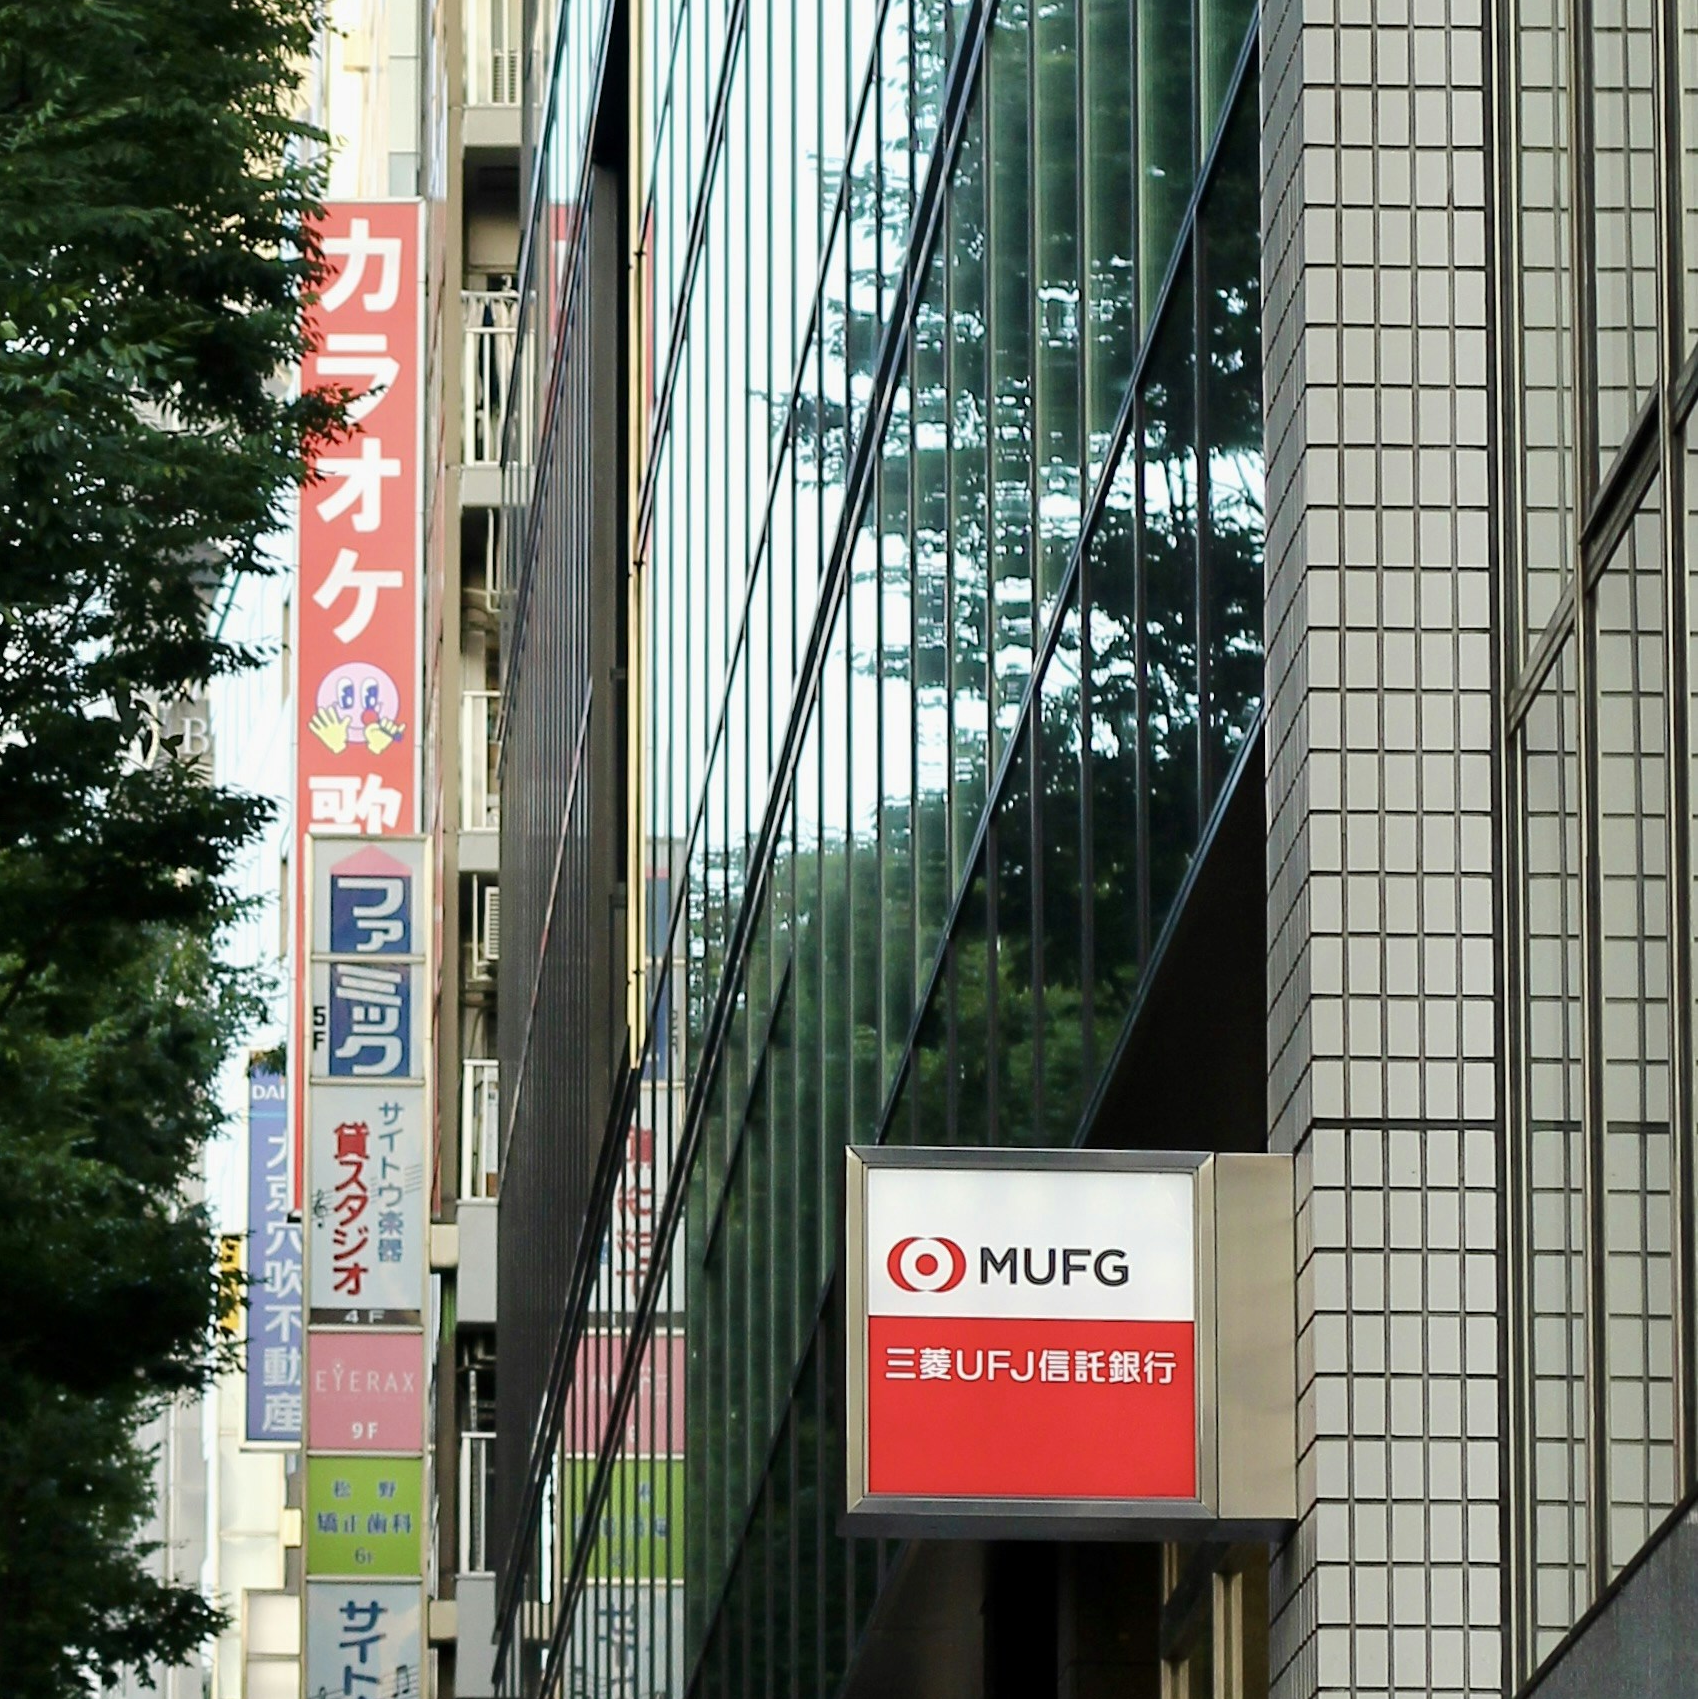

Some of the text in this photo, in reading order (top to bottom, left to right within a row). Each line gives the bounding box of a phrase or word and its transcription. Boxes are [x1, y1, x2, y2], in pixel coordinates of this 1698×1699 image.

[312, 217, 404, 645] カラオケ
[333, 1121, 370, 1295] 貸スタジオ
[979, 1247, 1130, 1286] MUFG
[885, 1346, 1178, 1385] 三菱UFJ信託銀行
[352, 1422, 379, 1440] 9F
